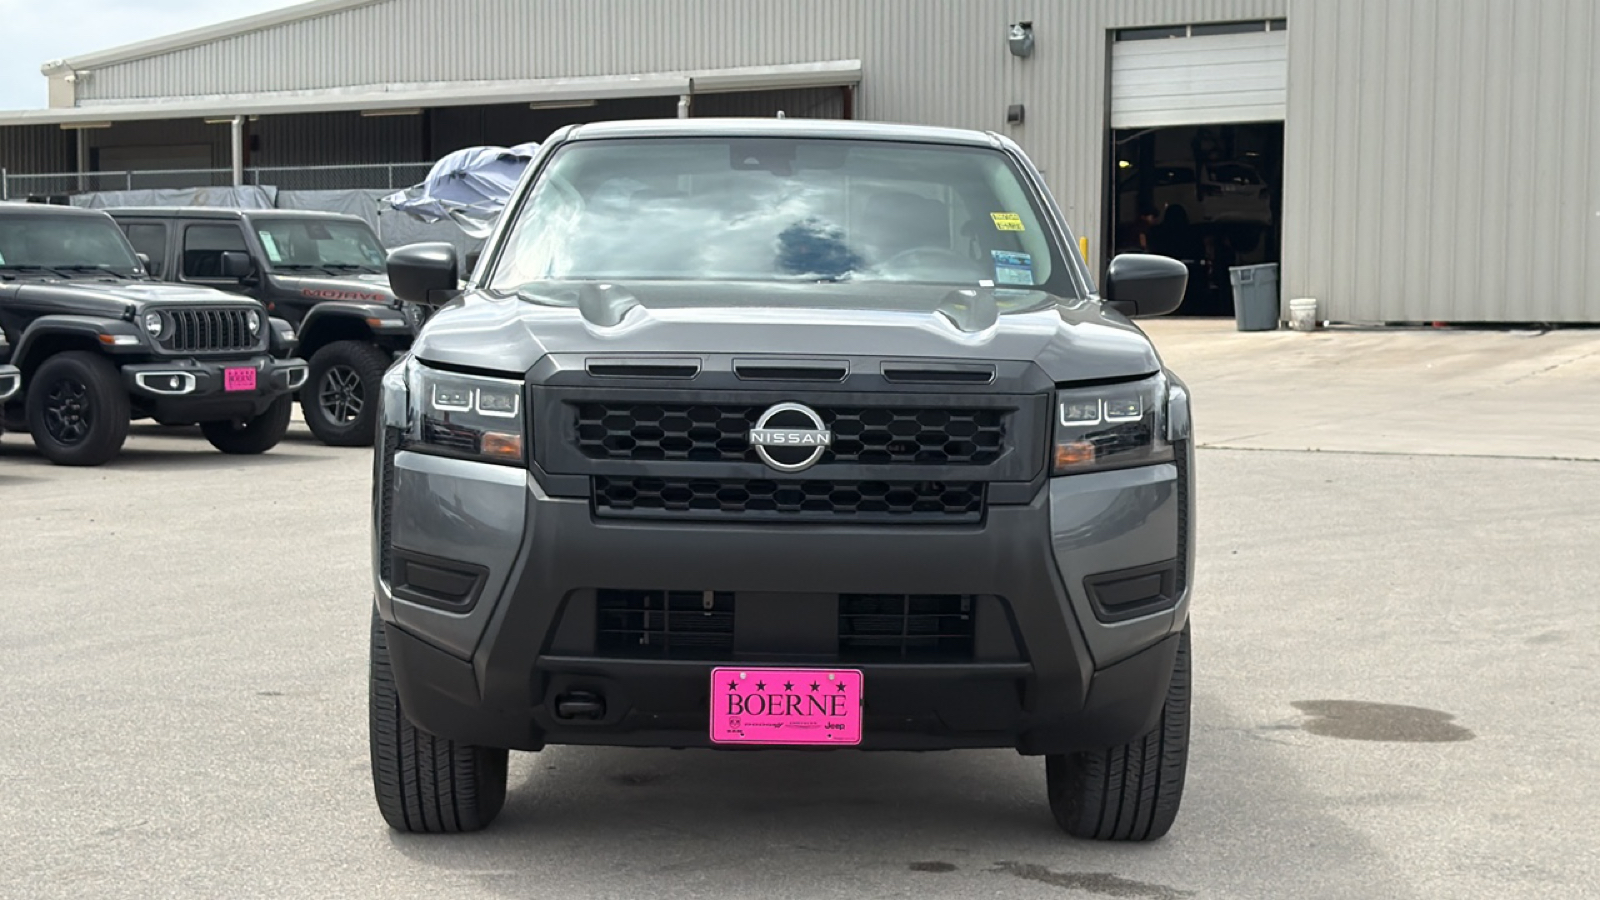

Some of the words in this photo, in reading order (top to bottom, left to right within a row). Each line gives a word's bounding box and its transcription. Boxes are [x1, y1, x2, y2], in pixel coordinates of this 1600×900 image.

[752, 432, 830, 443] NISSAN
[726, 693, 848, 716] BOERNE
[825, 721, 845, 730] Jeep
